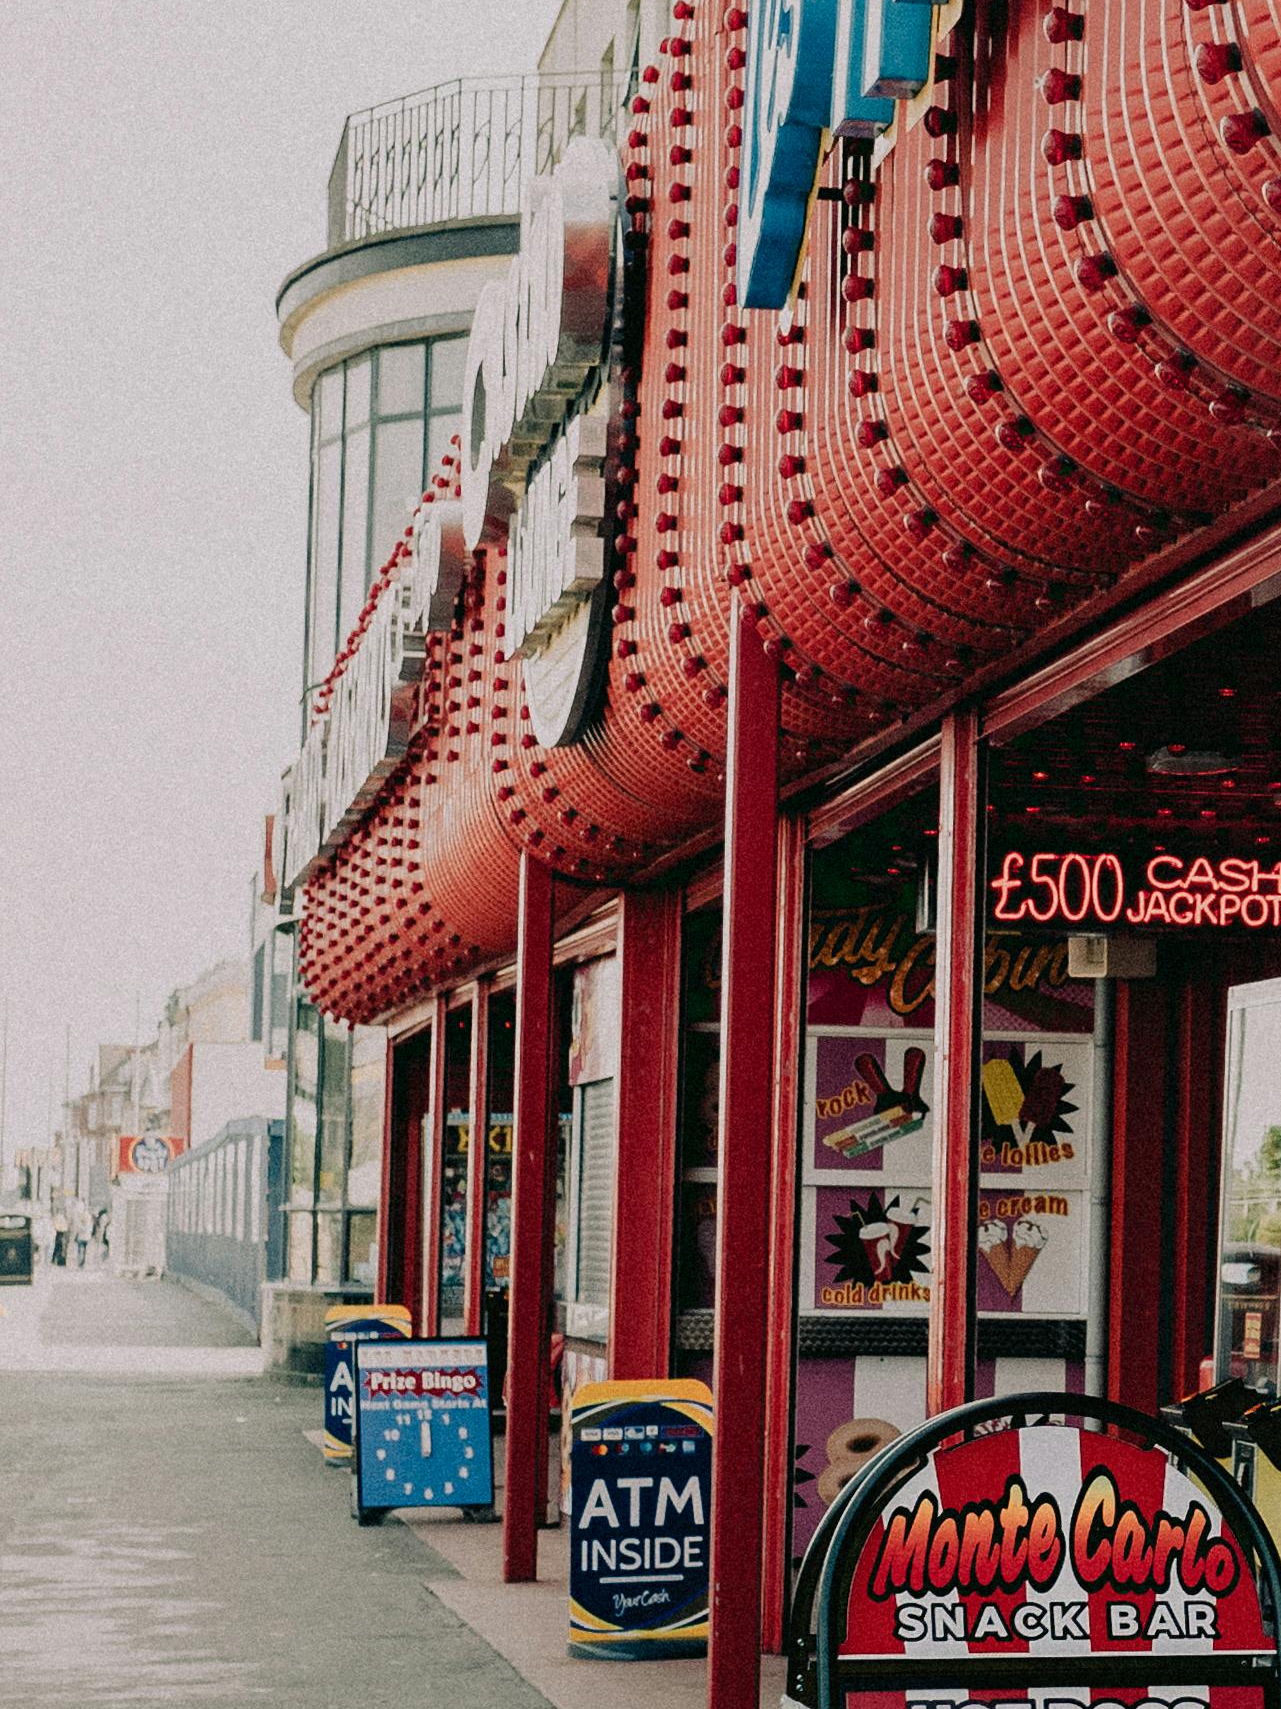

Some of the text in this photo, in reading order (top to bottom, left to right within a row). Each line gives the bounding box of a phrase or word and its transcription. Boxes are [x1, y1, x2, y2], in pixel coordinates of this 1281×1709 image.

[992, 852, 1123, 921] £500
[816, 1077, 873, 1119] rock
[1002, 1139, 1076, 1168] lollies
[998, 1195, 1069, 1218] cream
[822, 1282, 863, 1306] cold
[370, 1372, 476, 1392] Prize Bingo
[578, 1476, 704, 1529] ATM
[868, 1465, 1241, 1600] Monte Carlo
[581, 1536, 703, 1571] INSIDE
[895, 1601, 1221, 1641] SNACK BAR
